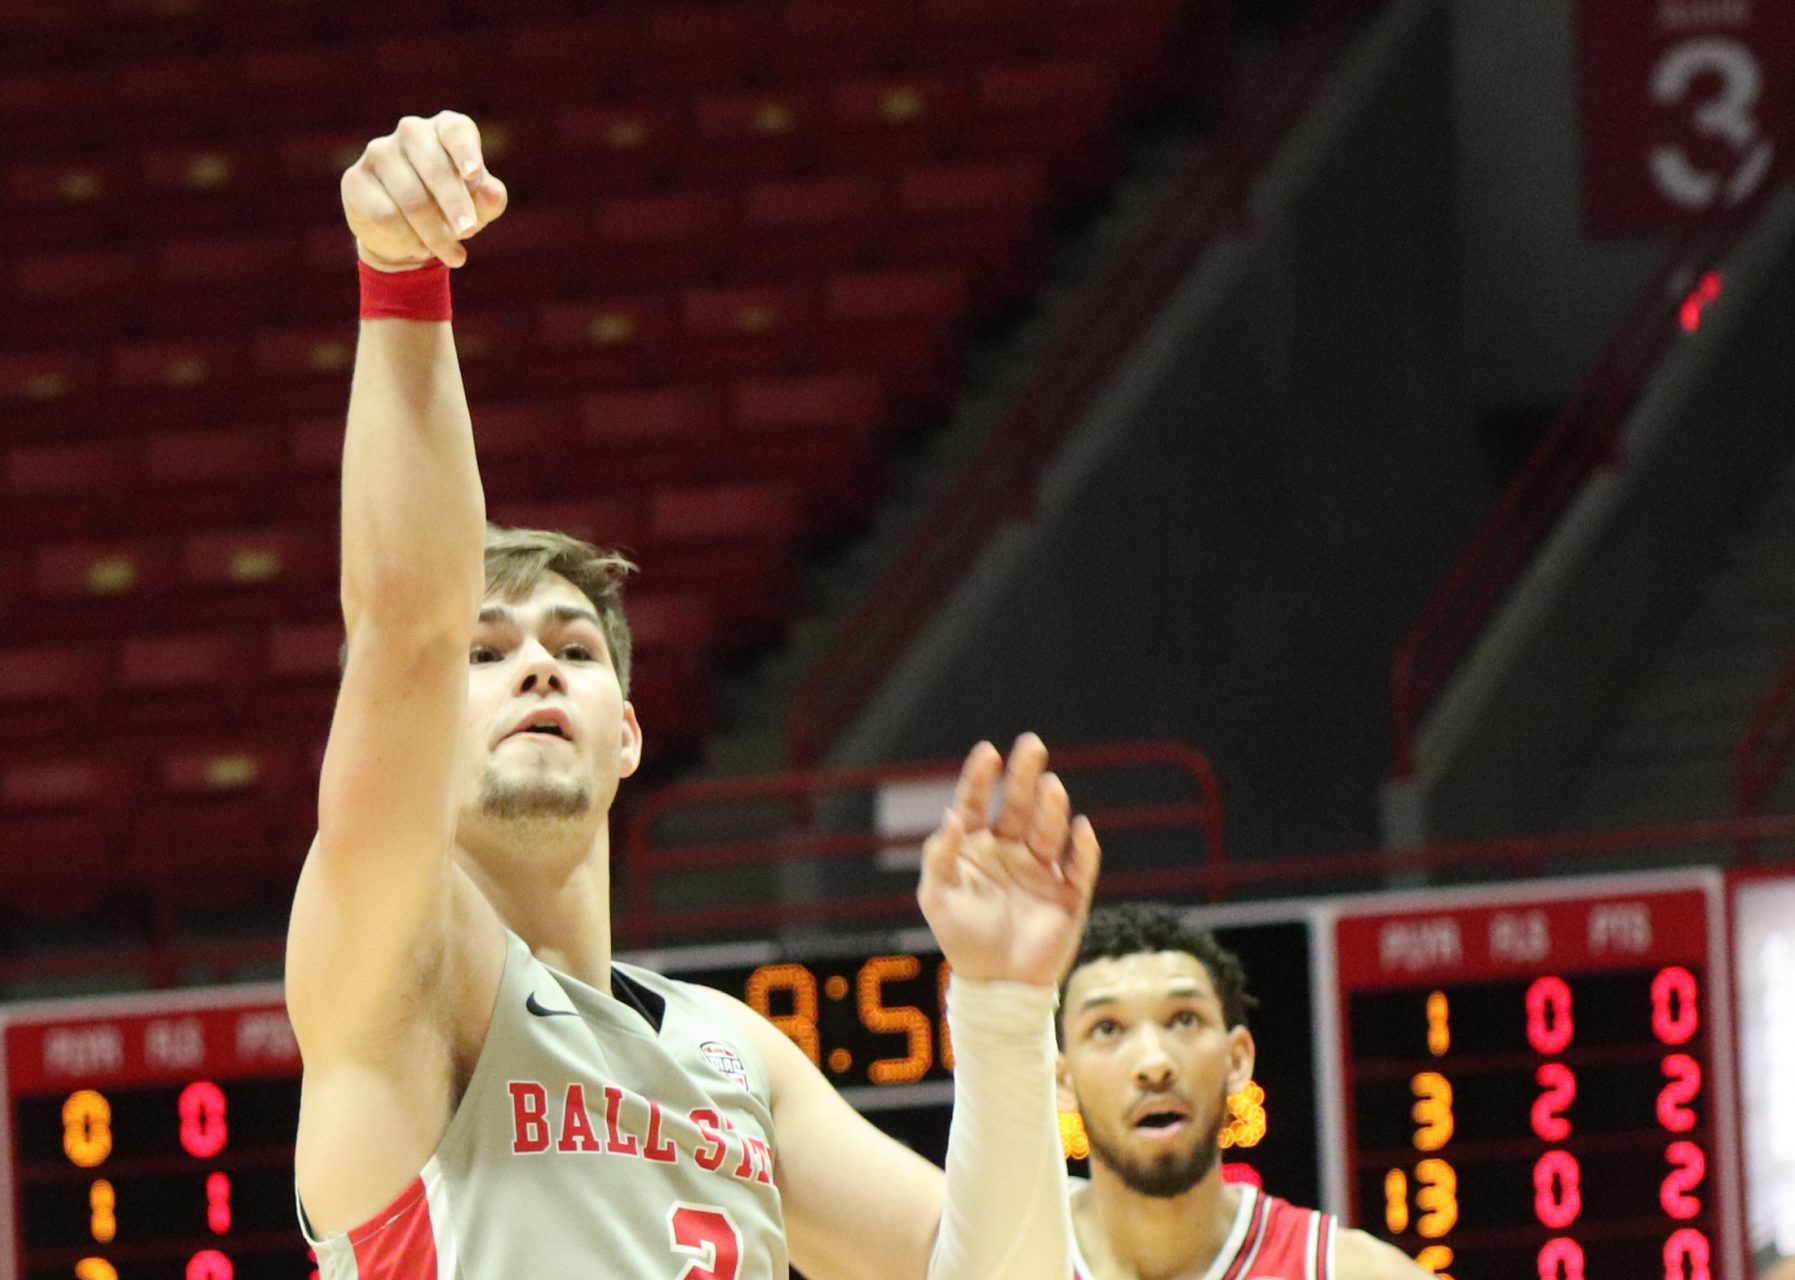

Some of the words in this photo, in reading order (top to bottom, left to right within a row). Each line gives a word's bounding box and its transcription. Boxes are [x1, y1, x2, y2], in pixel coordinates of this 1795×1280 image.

[1652, 38, 1772, 207] 3
[1427, 992, 1450, 1056] 1
[1526, 975, 1573, 1055] 0
[1651, 966, 1698, 1045] 0
[62, 1089, 112, 1167] 0
[178, 1080, 228, 1158] 0
[508, 1080, 677, 1165] BALL
[1412, 1071, 1454, 1151] 3
[1531, 1062, 1576, 1142] 2
[1656, 1053, 1701, 1132] 2
[1385, 1158, 1459, 1238] 13
[1533, 1149, 1582, 1229] 0
[1660, 1140, 1706, 1220] 2
